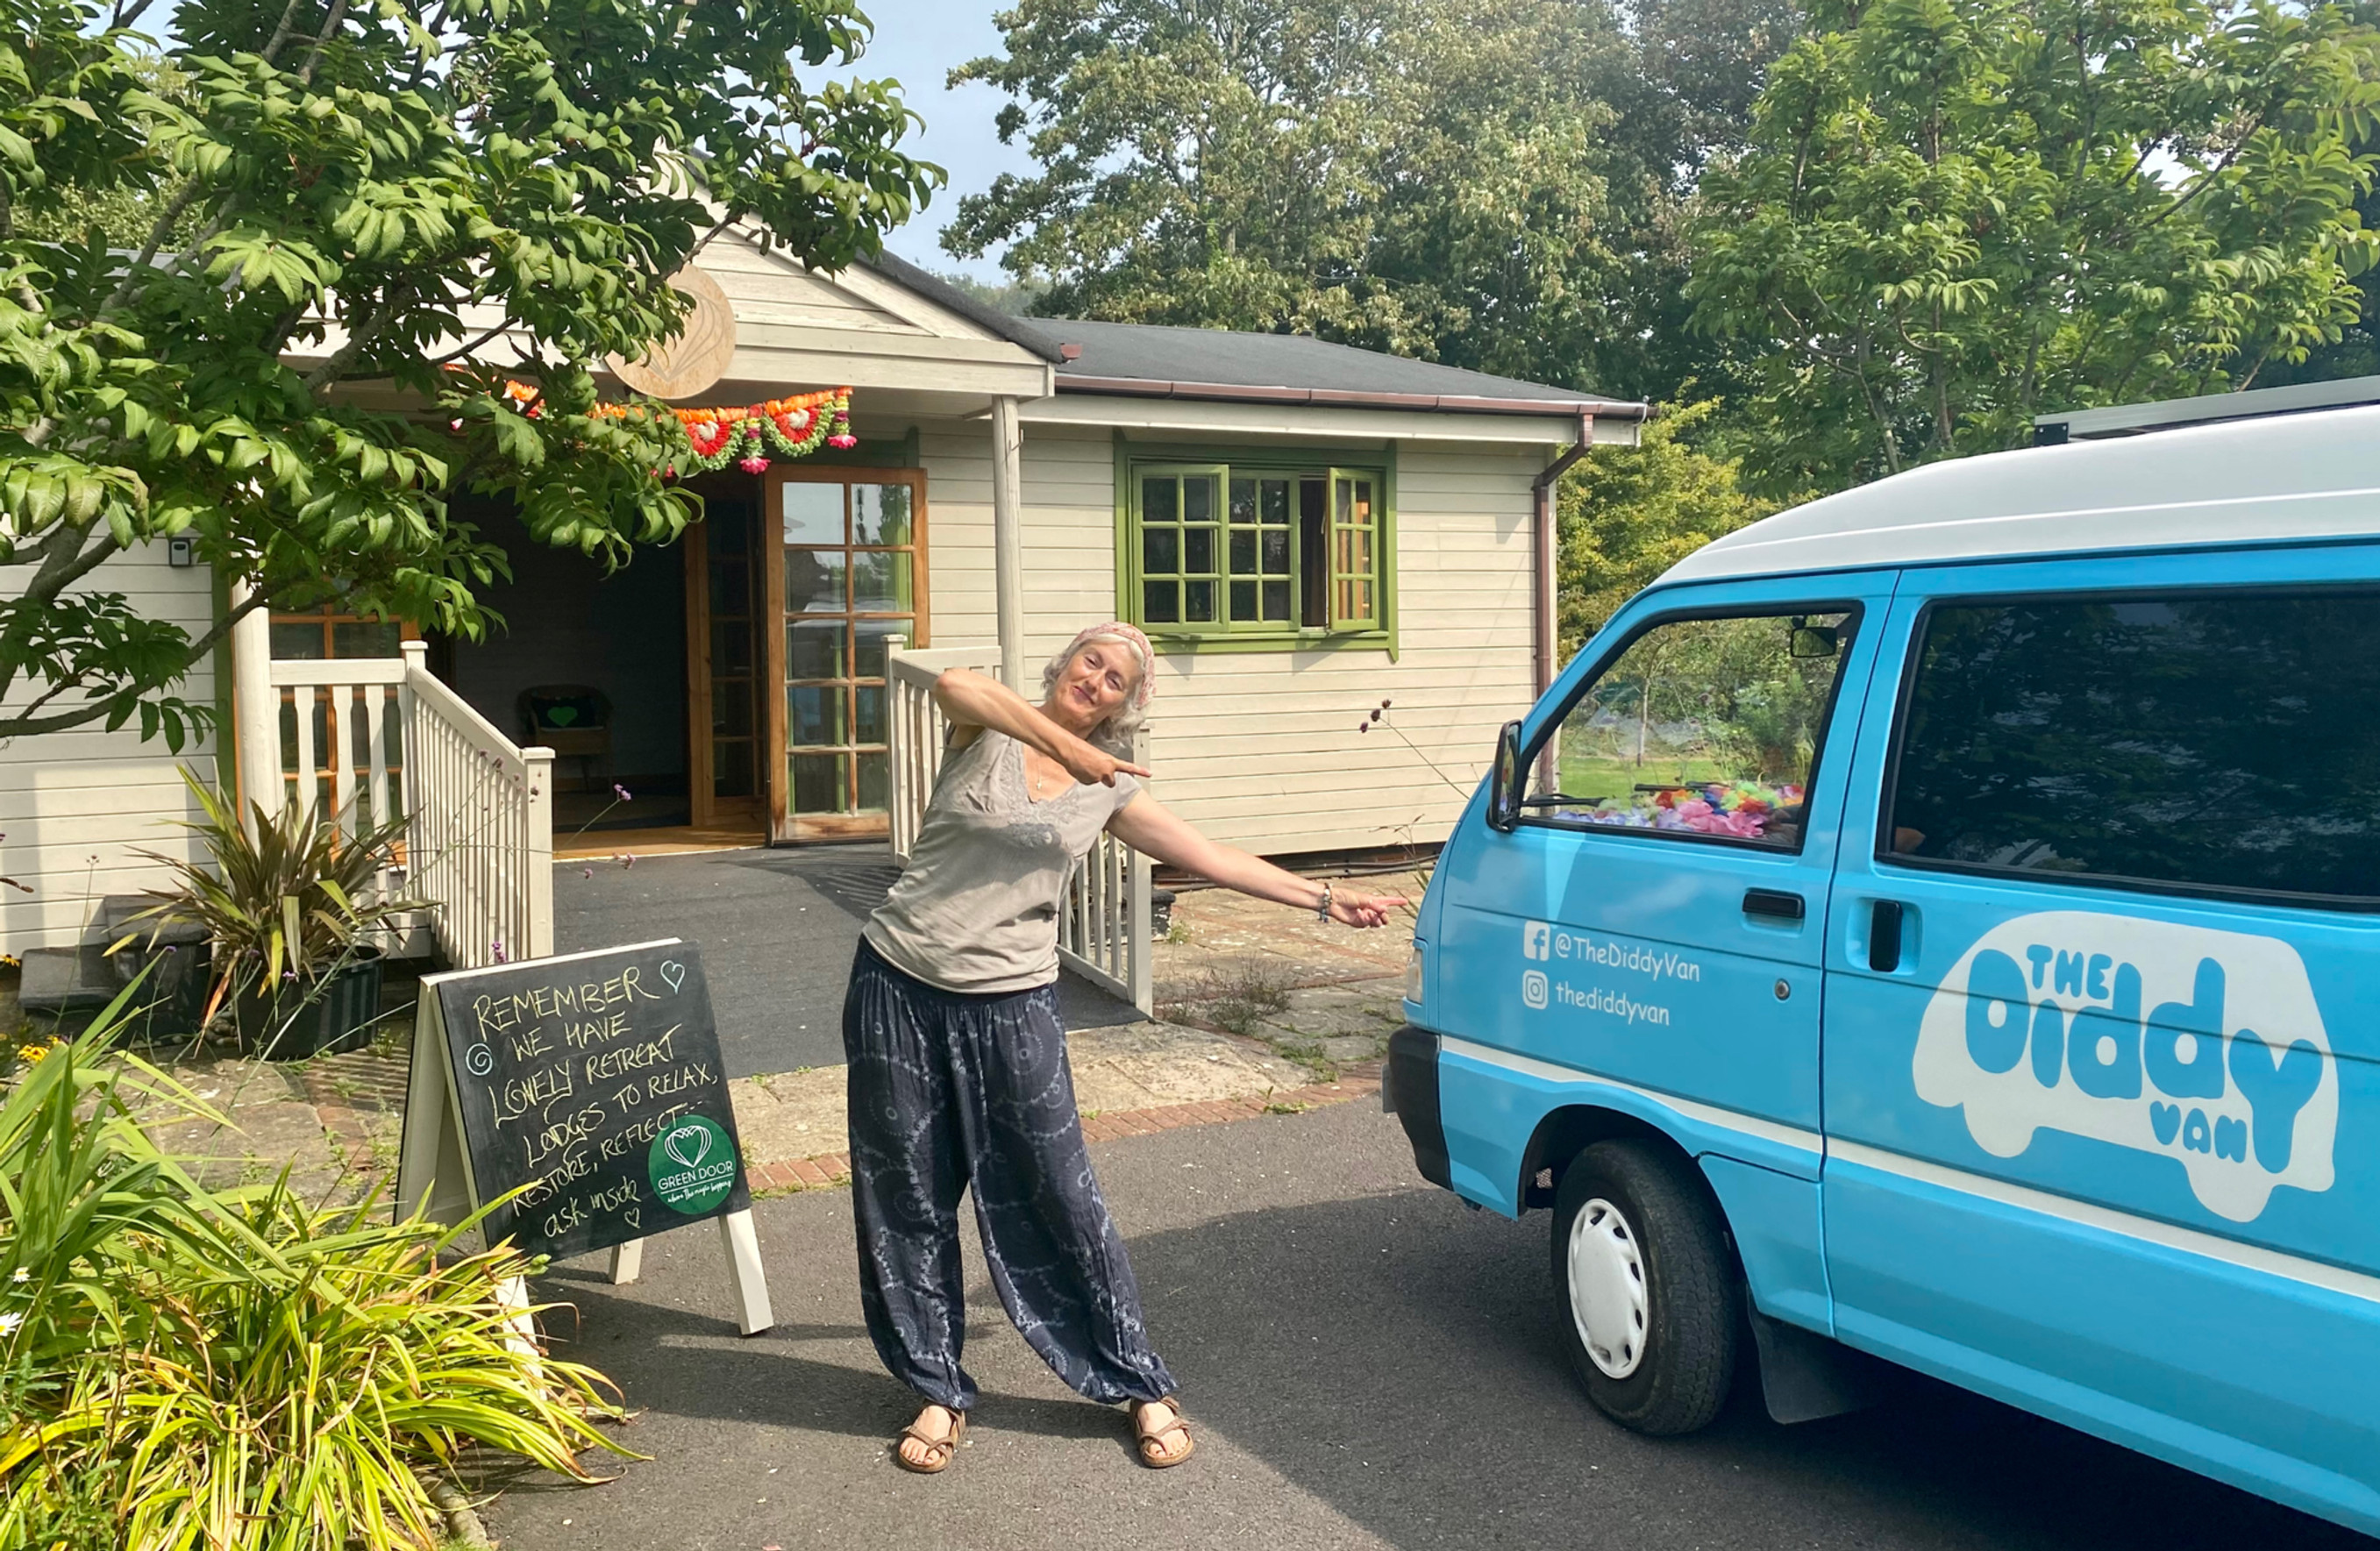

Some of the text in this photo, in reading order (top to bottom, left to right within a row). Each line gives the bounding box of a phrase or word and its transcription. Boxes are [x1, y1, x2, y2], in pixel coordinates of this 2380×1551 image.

[1555, 933, 1700, 982] @TheDiddyVan
[2027, 943, 2113, 1000] THE
[473, 966, 661, 1042] REMEMBER
[1555, 981, 1670, 1026] thediddyvan
[512, 1011, 632, 1062] WE HAVE
[488, 1023, 682, 1129] LOVELY RETREAT
[524, 1063, 718, 1169] LODGES TO RELAX,
[658, 1161, 733, 1190] GREEN DOOR
[545, 1196, 588, 1237] ask
